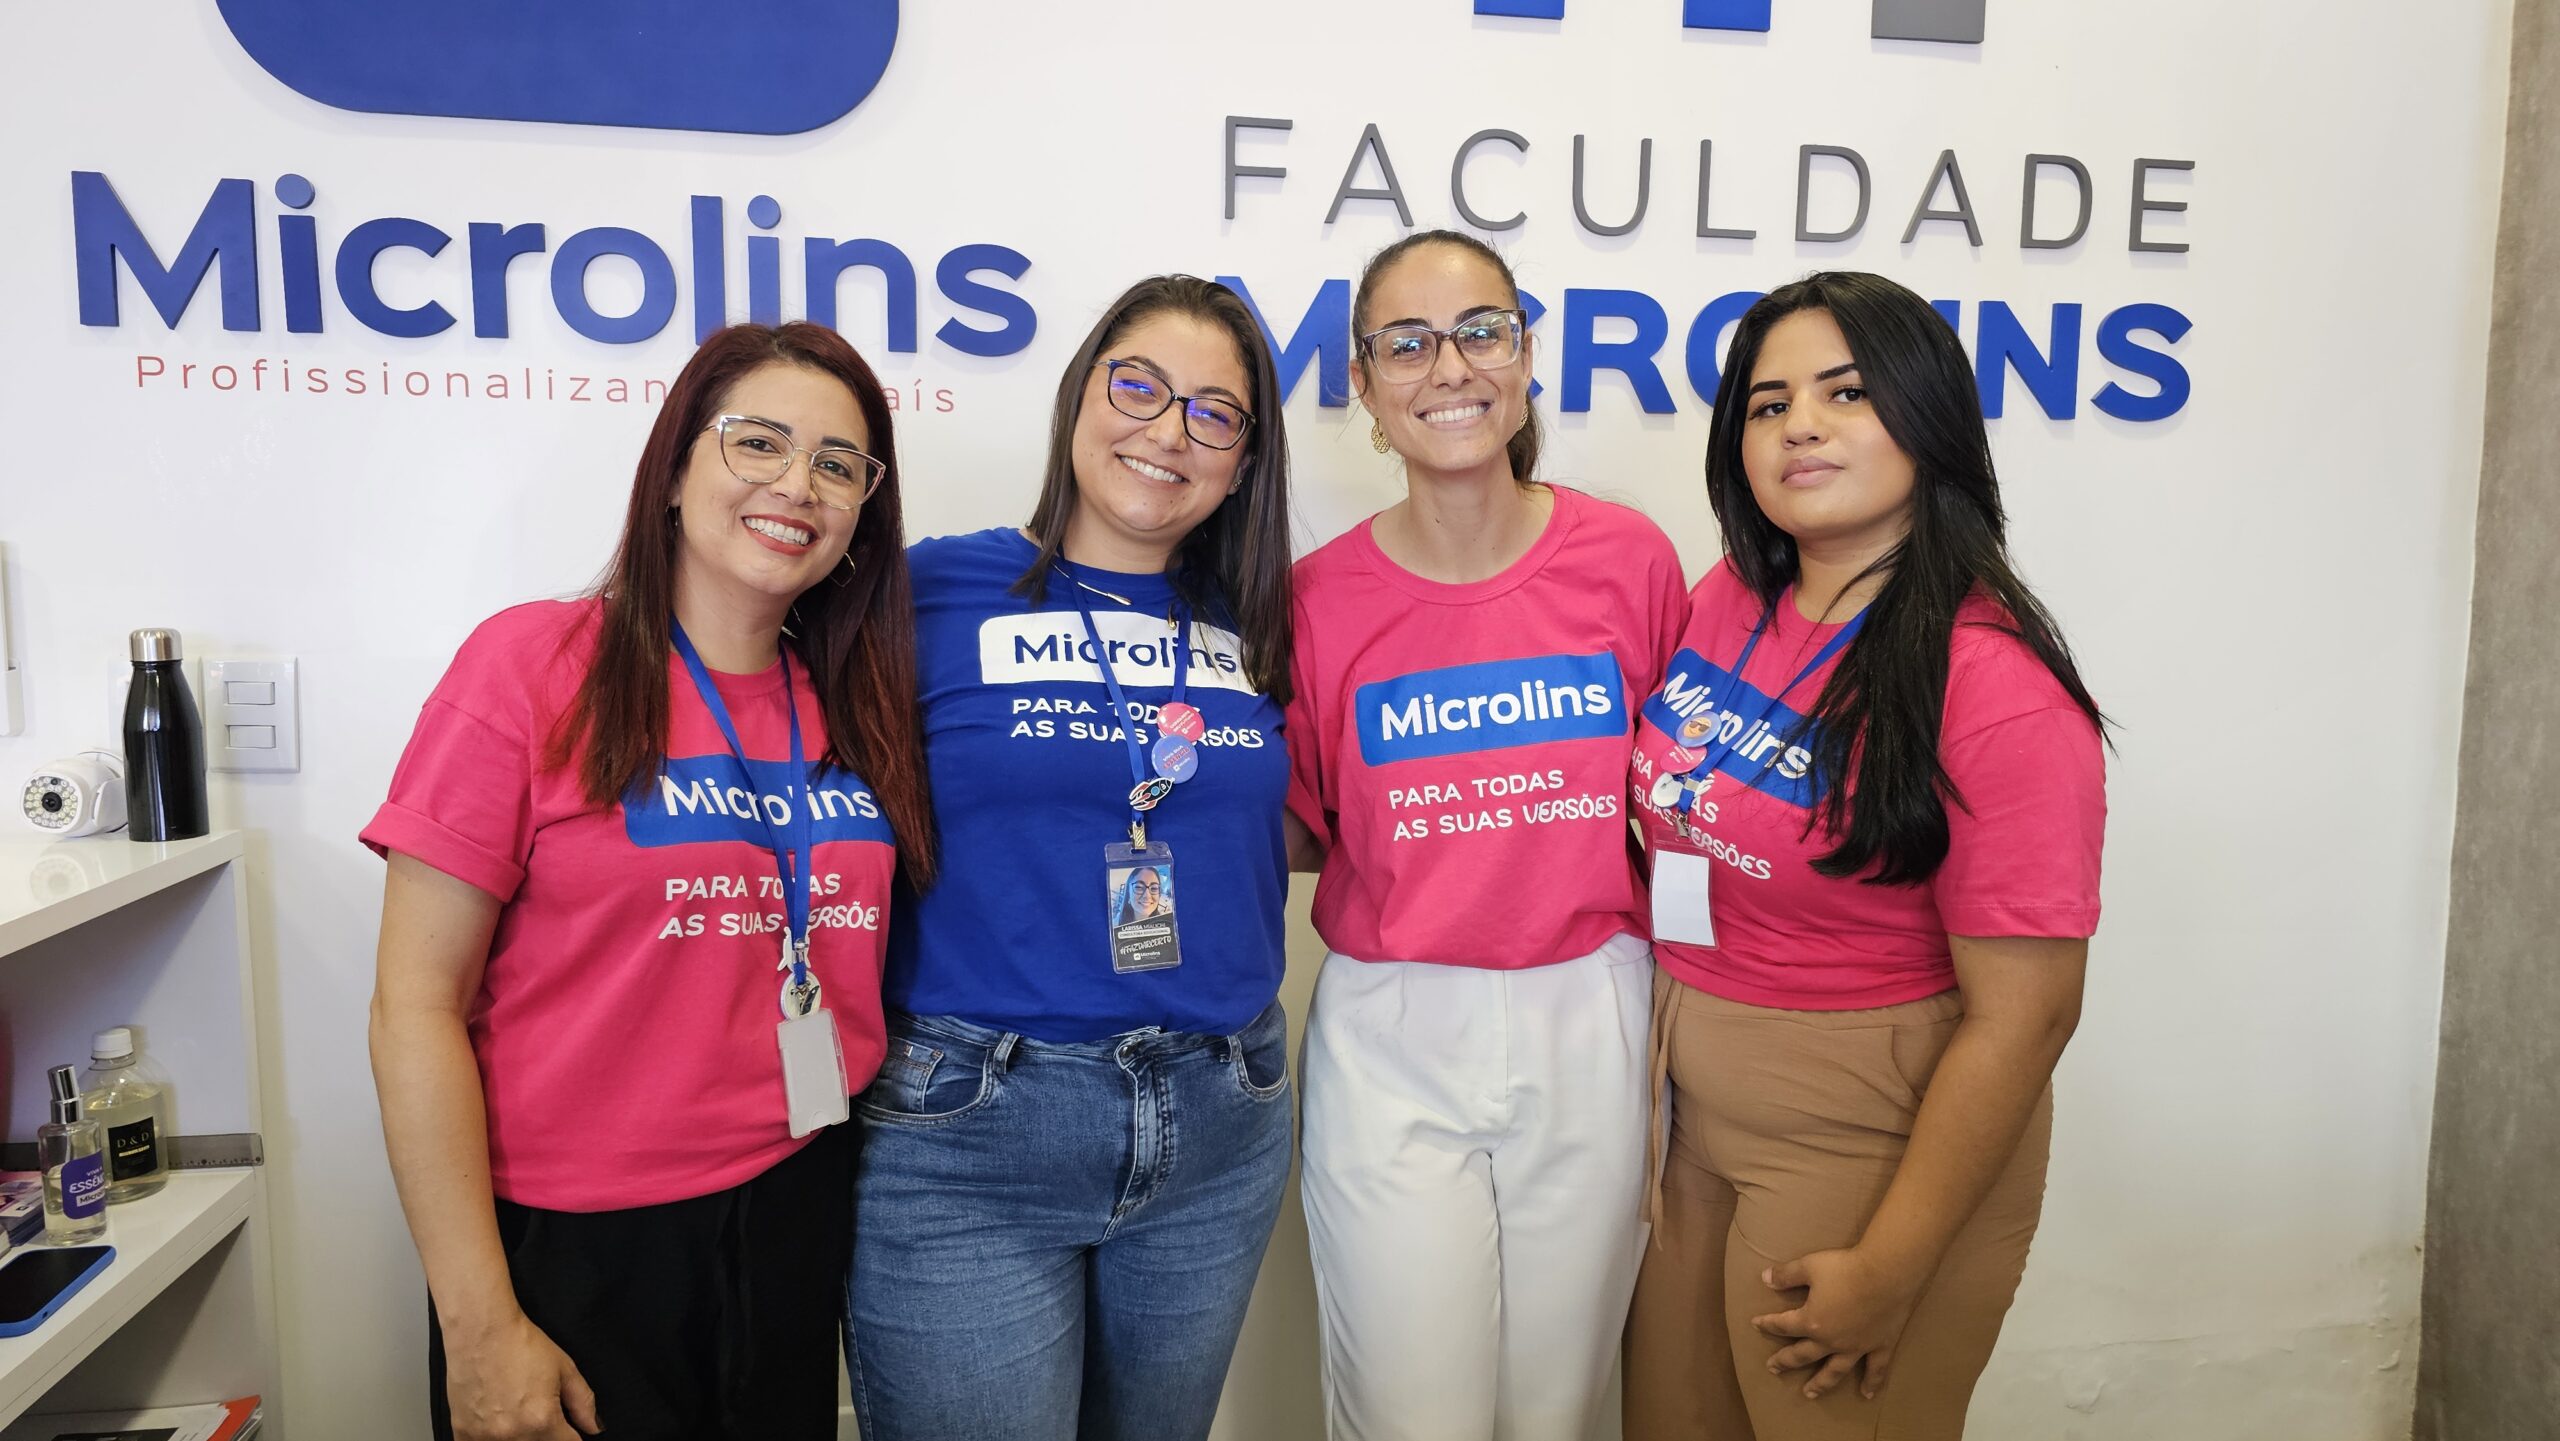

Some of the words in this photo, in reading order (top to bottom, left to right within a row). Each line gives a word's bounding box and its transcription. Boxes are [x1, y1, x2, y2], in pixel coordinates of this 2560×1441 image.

[1224, 115, 2195, 253] FACULDADE
[71, 170, 1037, 357] Microlins
[137, 355, 669, 403] Profissionalizan
[882, 378, 955, 413] aís
[1012, 697, 1098, 715] PARA
[1381, 680, 1612, 741] Microlins
[1010, 720, 1056, 738] AS
[1069, 721, 1149, 745] SUAS
[1632, 746, 1653, 780] ARA
[1388, 783, 1463, 810] PARA
[1472, 769, 1565, 798] TODAS
[1393, 818, 1429, 841] AS
[1438, 808, 1513, 835] SUAS
[1522, 793, 1617, 825] VERSÕES
[666, 875, 748, 900] PARA
[758, 873, 842, 899] TOAS
[658, 914, 705, 939] AS
[719, 912, 784, 936] SUAS
